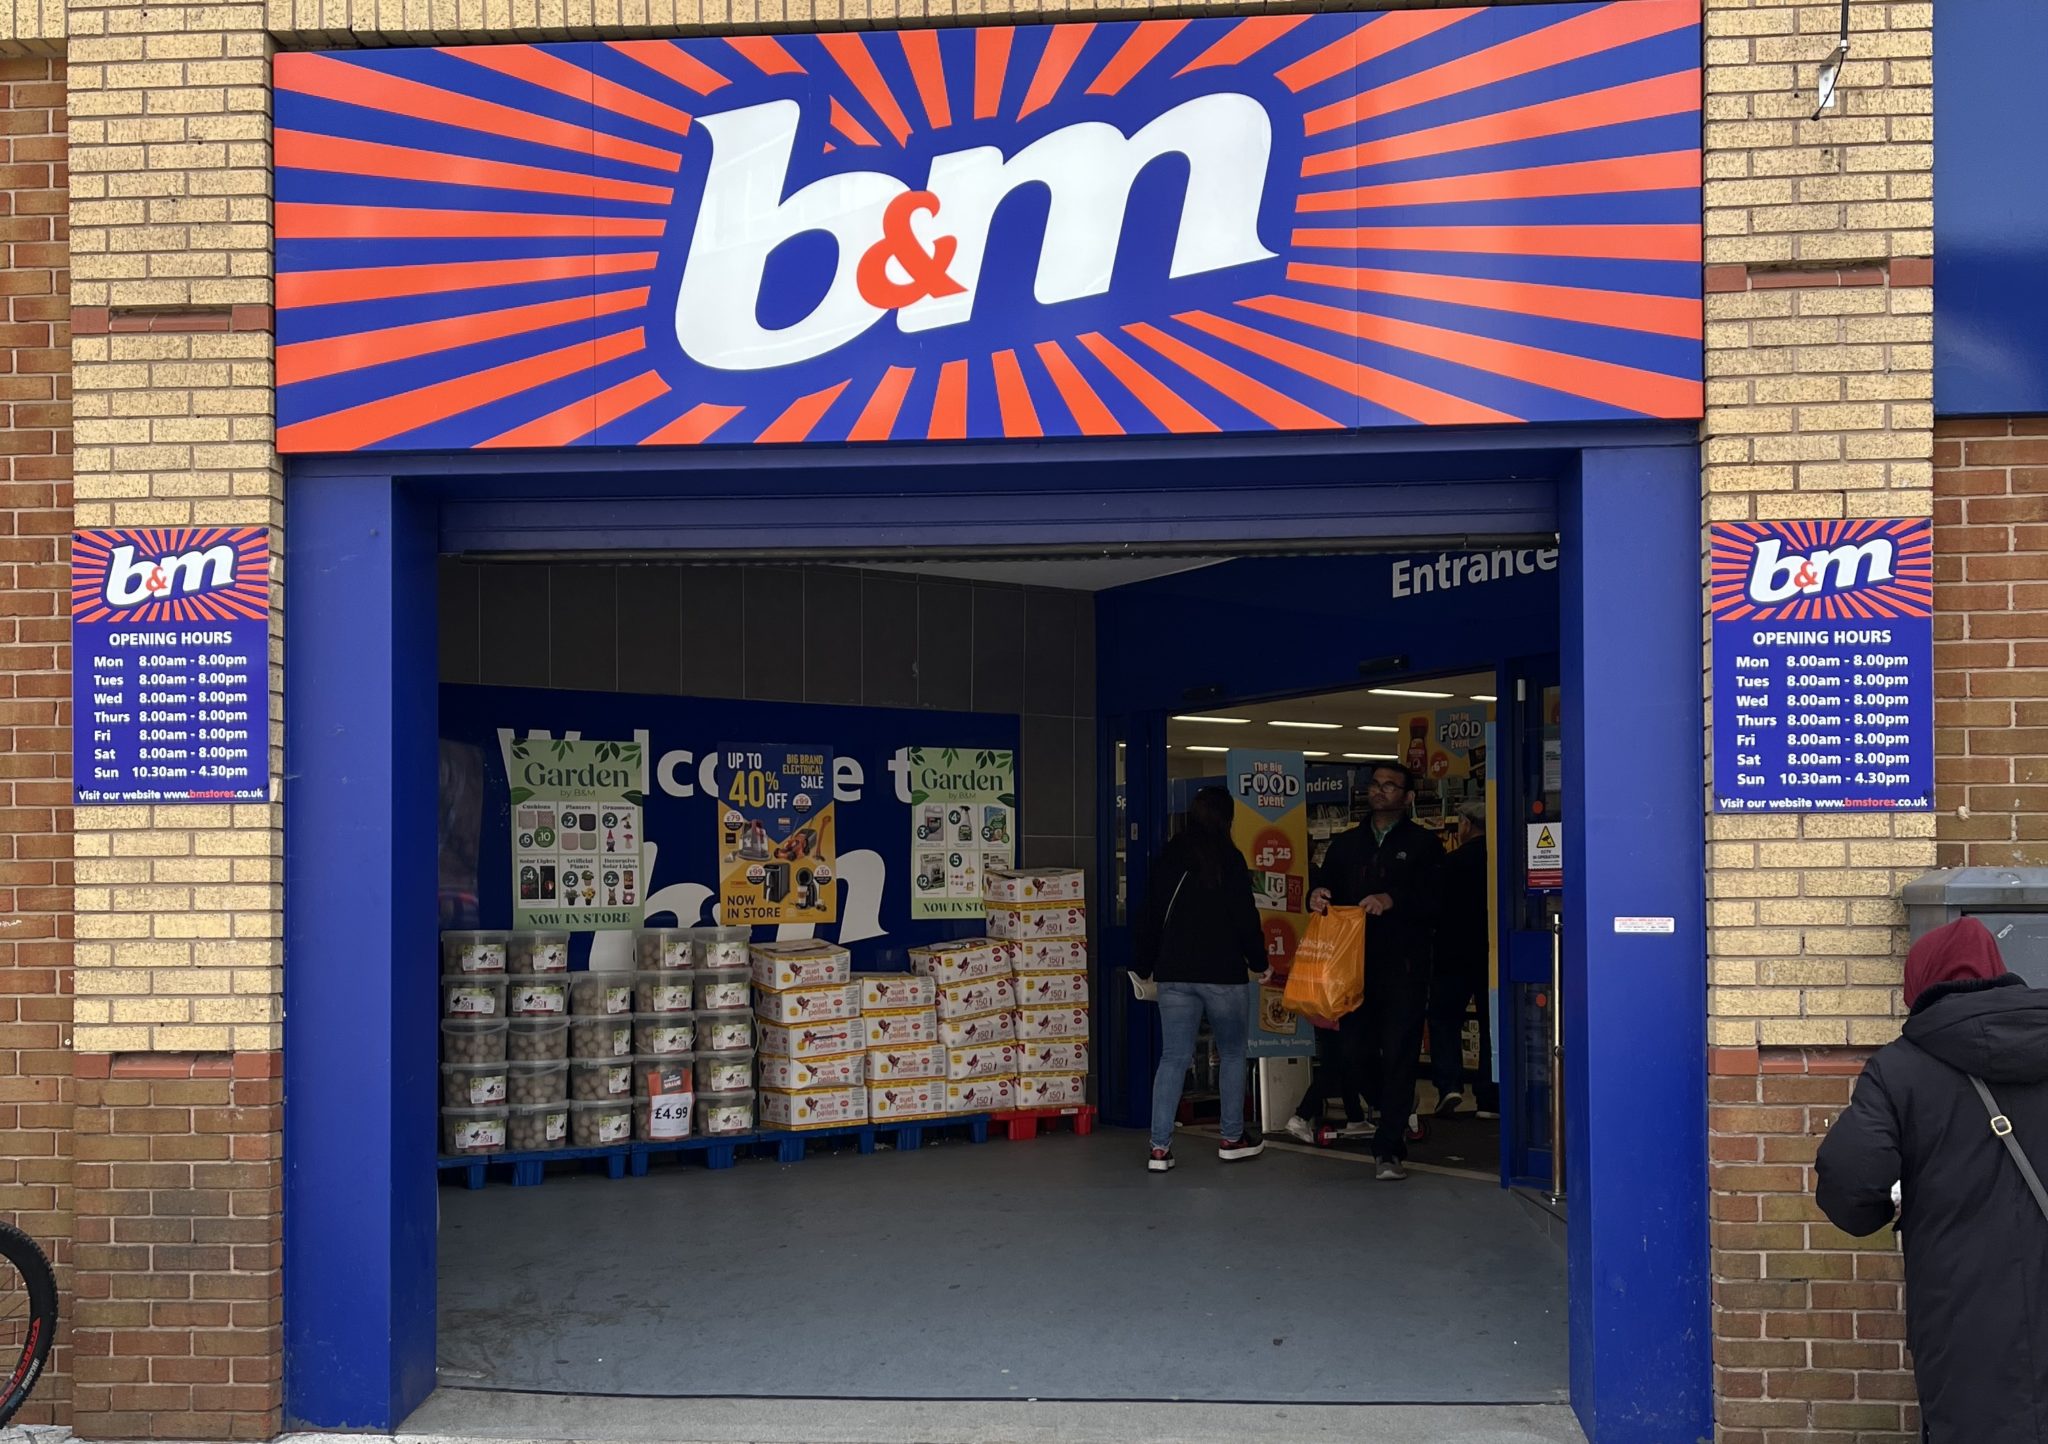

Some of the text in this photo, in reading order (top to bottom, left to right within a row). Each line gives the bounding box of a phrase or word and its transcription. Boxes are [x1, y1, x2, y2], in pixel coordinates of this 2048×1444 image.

[675, 92, 1280, 371] b&m
[106, 545, 235, 606] b&m
[1392, 549, 1559, 598] Entrance
[1749, 538, 1894, 602] b&m
[108, 630, 233, 646] OPENING HOURS
[1752, 629, 1892, 646] OPENING HOURS
[93, 653, 247, 668] Mon 8.00am 8.00pm
[1736, 653, 1909, 669] Mon 8.00am 8.00pm
[93, 672, 247, 687] Tues 8.00am 8.00pm
[1735, 673, 1909, 689] Tues 8.00am 8.00pm
[93, 690, 248, 705] Wed 8.00am 8.00pm
[1736, 693, 1909, 708] Wed 8.00am 8.00pm
[93, 709, 248, 724] Thurs 8.00am 8.00pm
[1736, 712, 1909, 728] Thurs 8.00am 8.00pm
[94, 727, 248, 742] Fri 8.00am 8.00pm
[1440, 721, 1481, 741] FOOD
[1736, 732, 1910, 747] Fri 8.00am 8.00pm
[94, 746, 248, 761] Sat 8.00am 8.00pm
[727, 752, 762, 769] UP TO
[786, 754, 824, 765] BIG BRAND
[1736, 752, 1910, 767] Sat 8.00am 8.00pm
[94, 764, 248, 779] Sun 10.30am 4.30pm
[524, 762, 629, 788] Garden
[782, 764, 824, 775] ELECTRICAL
[800, 775, 824, 789] SALE
[921, 767, 1004, 791] Garden
[1239, 773, 1300, 796] FOOD
[1306, 777, 1343, 793] ndries
[1737, 771, 1910, 787] Sun 10.30am 4.30pm
[78, 788, 264, 801] Visit our website www.bmstores.co.uk
[560, 789, 596, 798] by B&M
[766, 792, 788, 809] OFF
[1258, 795, 1285, 807] Event
[1719, 797, 1928, 809] Visit our website www.bmstores.co.uk
[727, 895, 756, 906] NOW
[922, 902, 987, 912] NOW IN STO
[529, 912, 631, 925] NOW IN STORE
[727, 907, 781, 918] IN STORE
[1268, 936, 1286, 956] £1
[655, 1106, 688, 1119] £4.99
